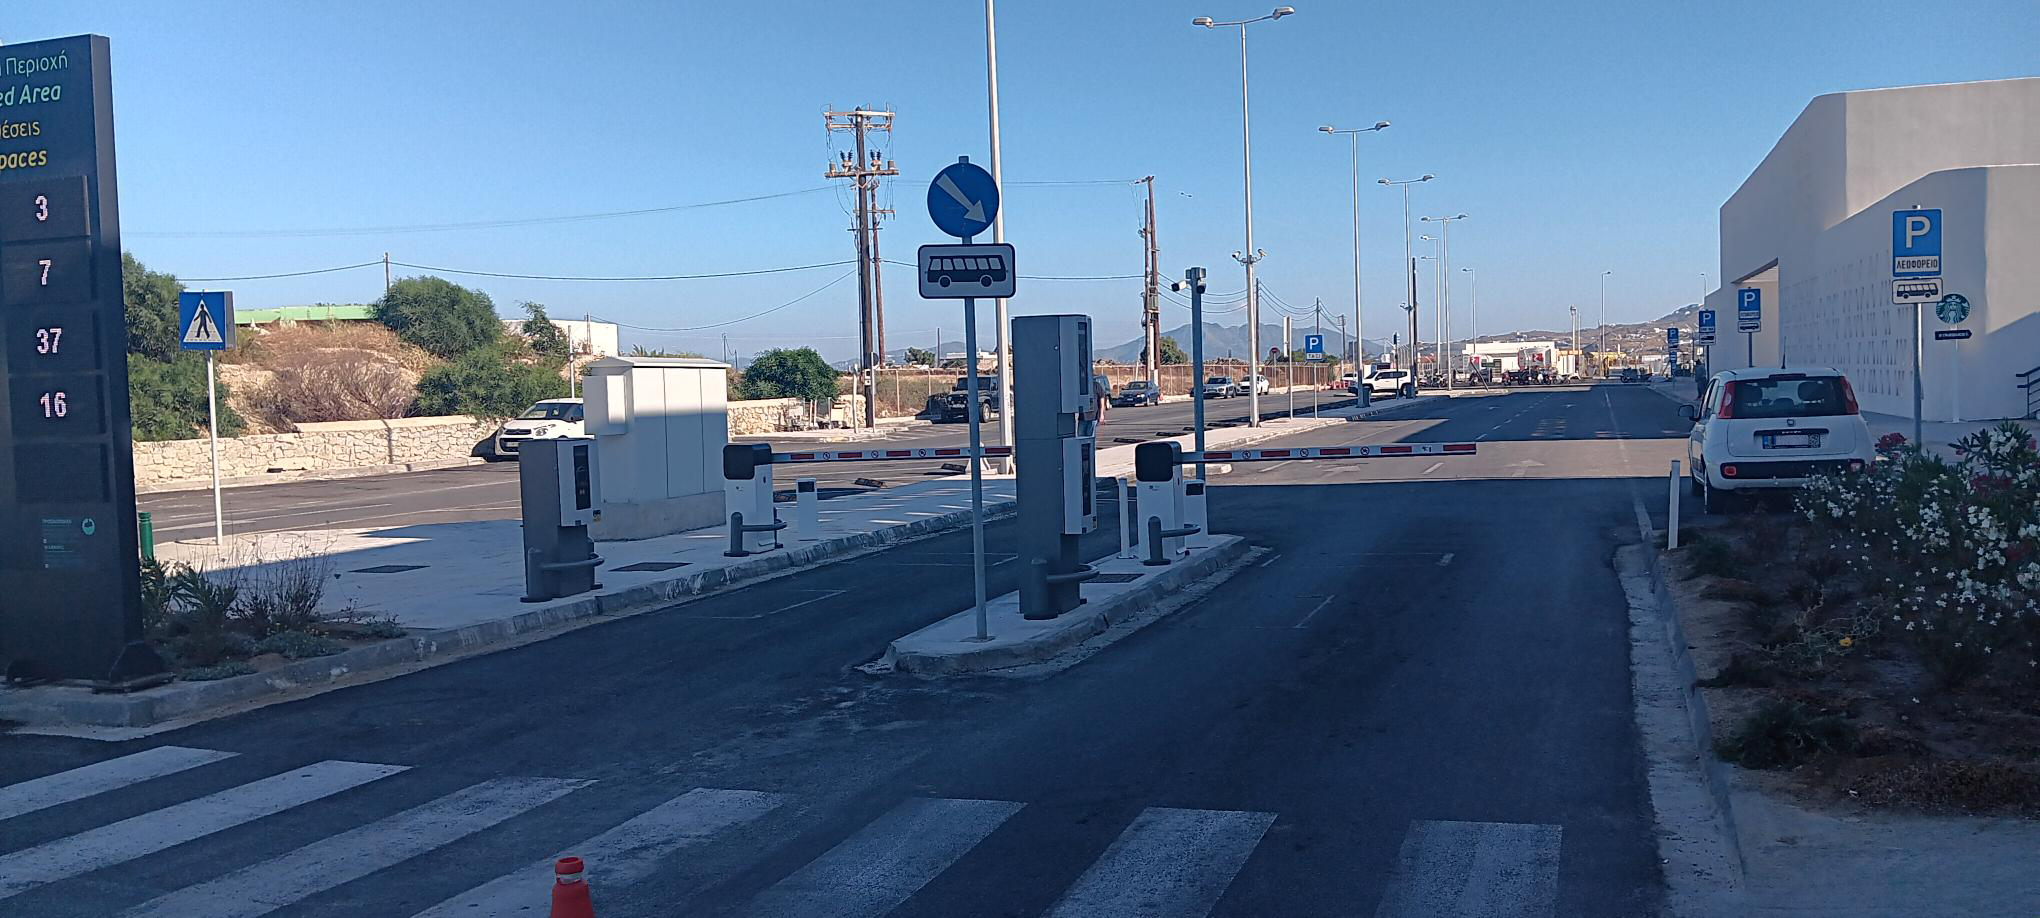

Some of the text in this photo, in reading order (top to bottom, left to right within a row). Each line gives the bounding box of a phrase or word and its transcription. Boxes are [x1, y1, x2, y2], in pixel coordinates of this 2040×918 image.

[6, 49, 68, 78] Περιοχή
[18, 84, 61, 105] Area
[0, 119, 41, 139] έσεις
[35, 195, 49, 221] 3
[1905, 215, 1931, 249] P
[38, 259, 52, 286] 7
[1744, 291, 1756, 307] P
[1703, 312, 1712, 325] P
[36, 327, 62, 354] 37
[1310, 337, 1319, 350] P
[40, 391, 67, 418] 16
